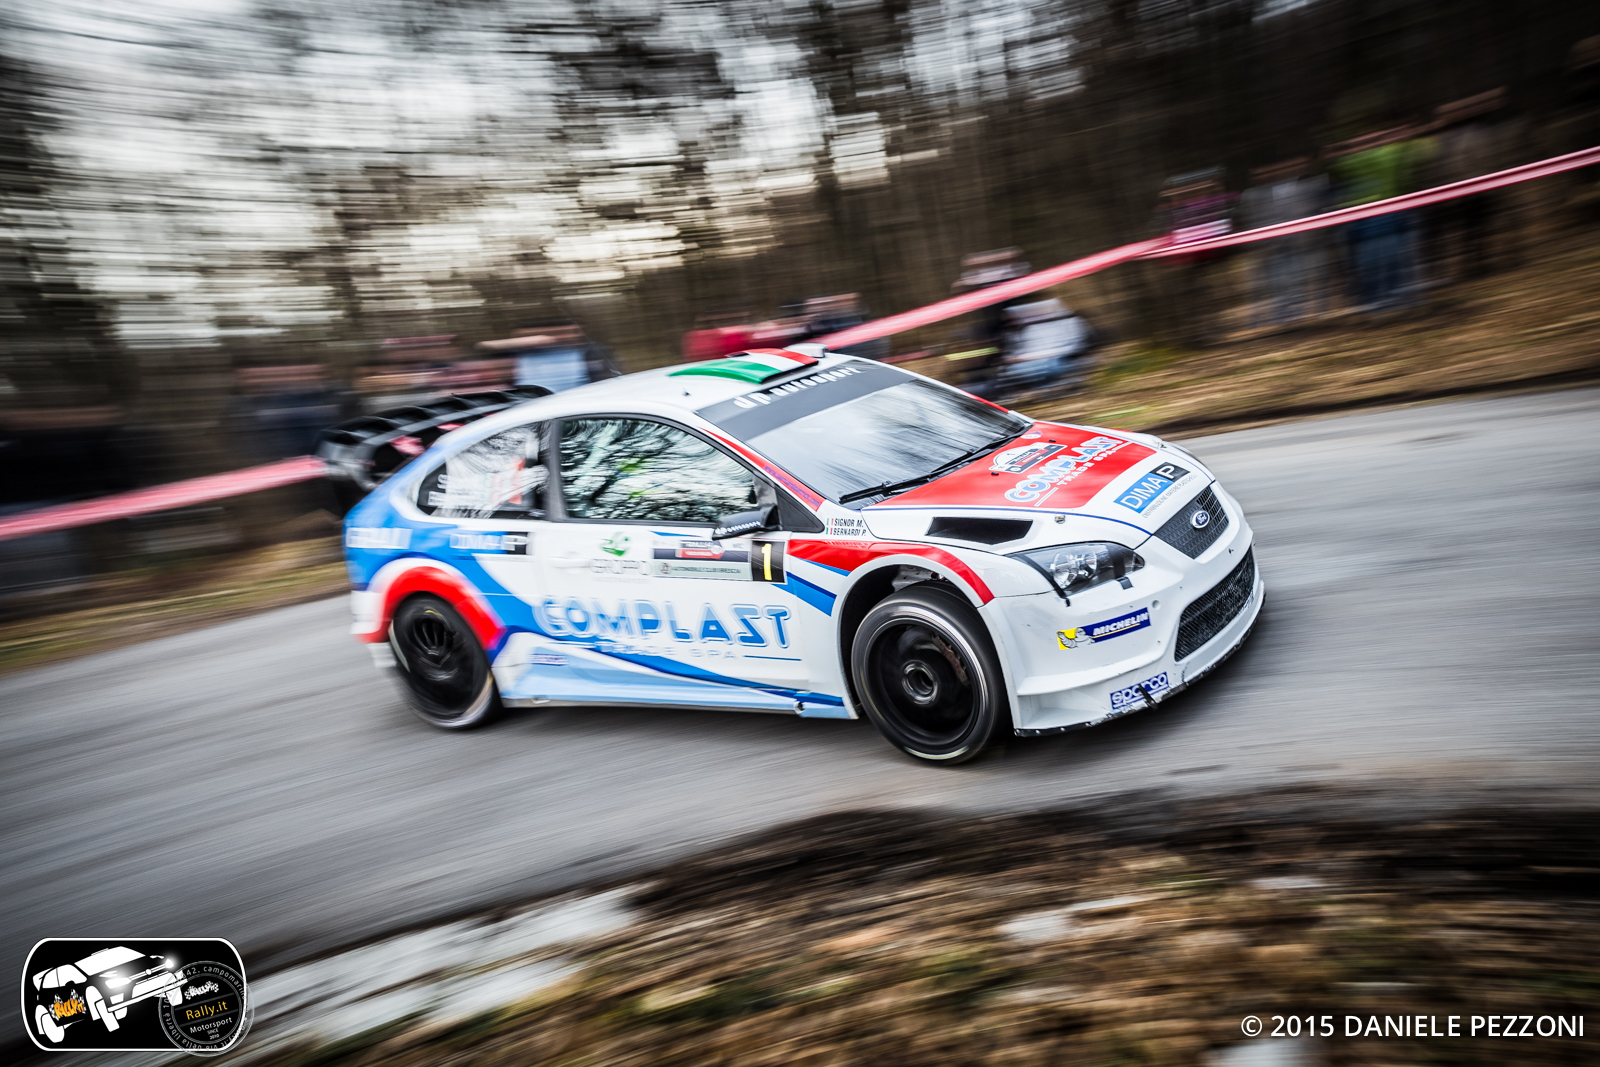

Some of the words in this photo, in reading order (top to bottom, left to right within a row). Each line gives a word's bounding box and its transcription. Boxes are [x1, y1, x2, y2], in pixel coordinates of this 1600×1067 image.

[834, 517, 855, 526] SIGNOR
[856, 518, 864, 527] M.
[832, 527, 861, 536] BERNARDI
[761, 543, 772, 581] 1
[1093, 612, 1149, 636] MICHELIN
